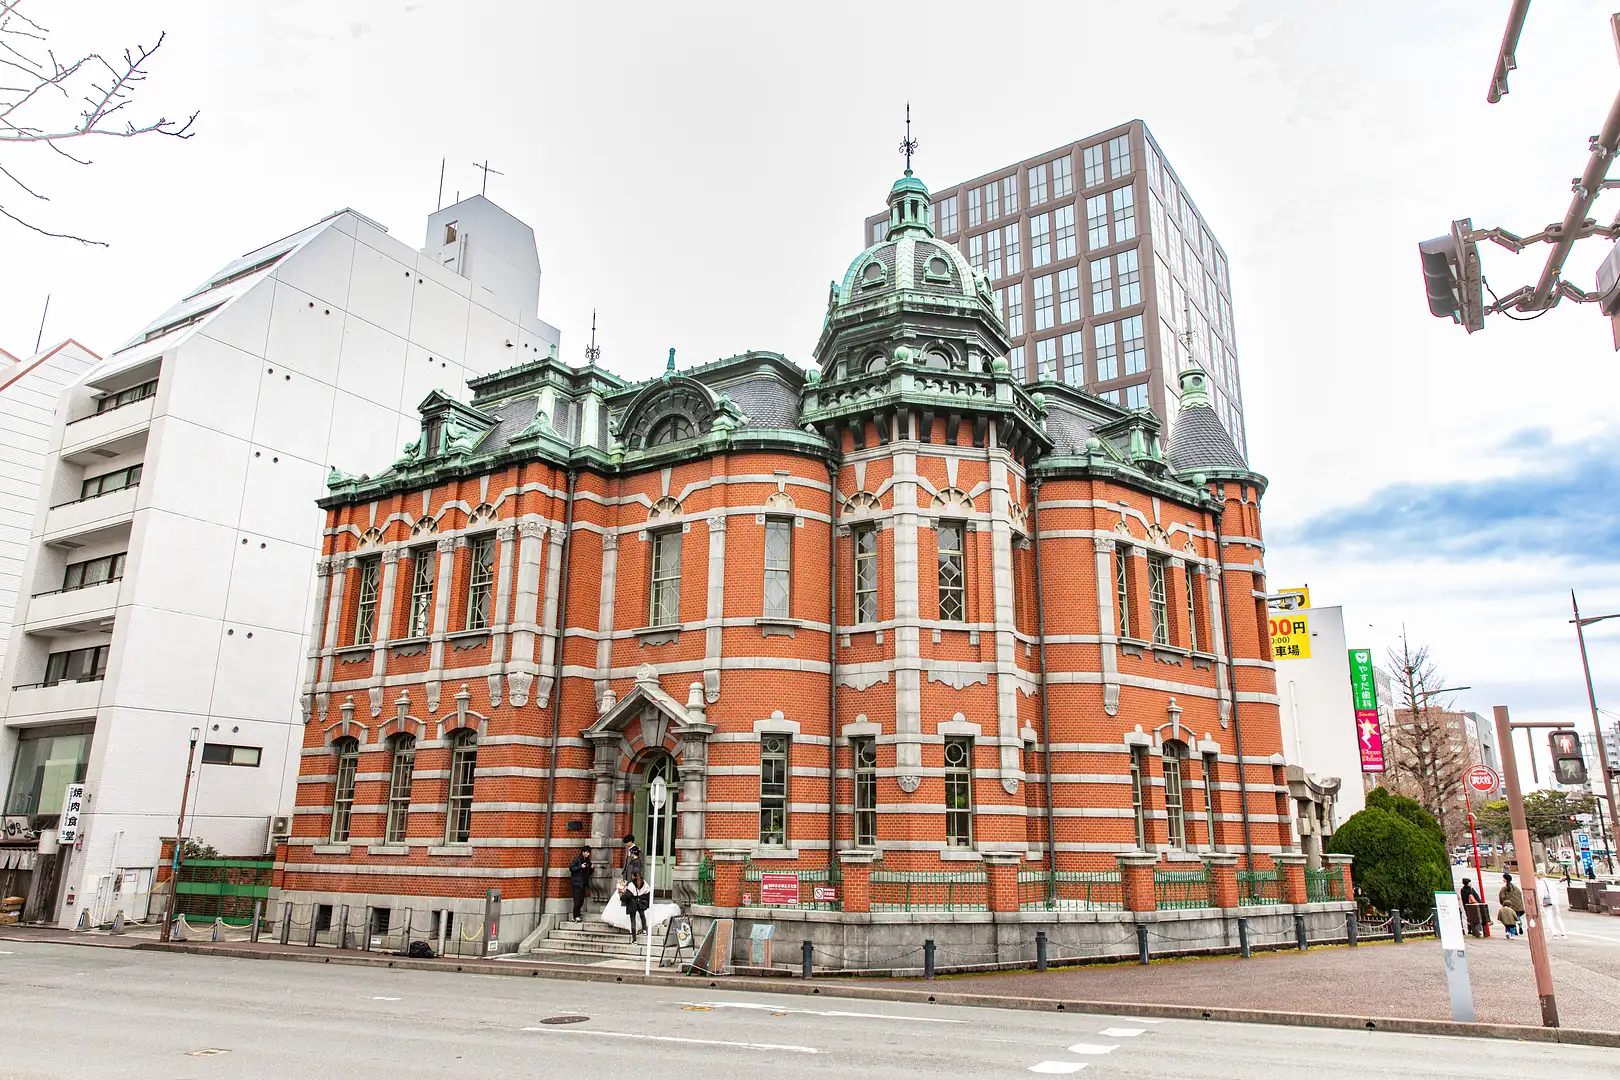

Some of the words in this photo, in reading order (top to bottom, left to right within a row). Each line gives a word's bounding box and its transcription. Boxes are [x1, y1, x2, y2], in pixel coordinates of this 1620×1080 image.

[1273, 645, 1300, 657] 車場
[1358, 665, 1372, 708] やすだ歯科
[1471, 776, 1493, 785] 消火栓
[65, 788, 83, 840] 焼肉食堂
